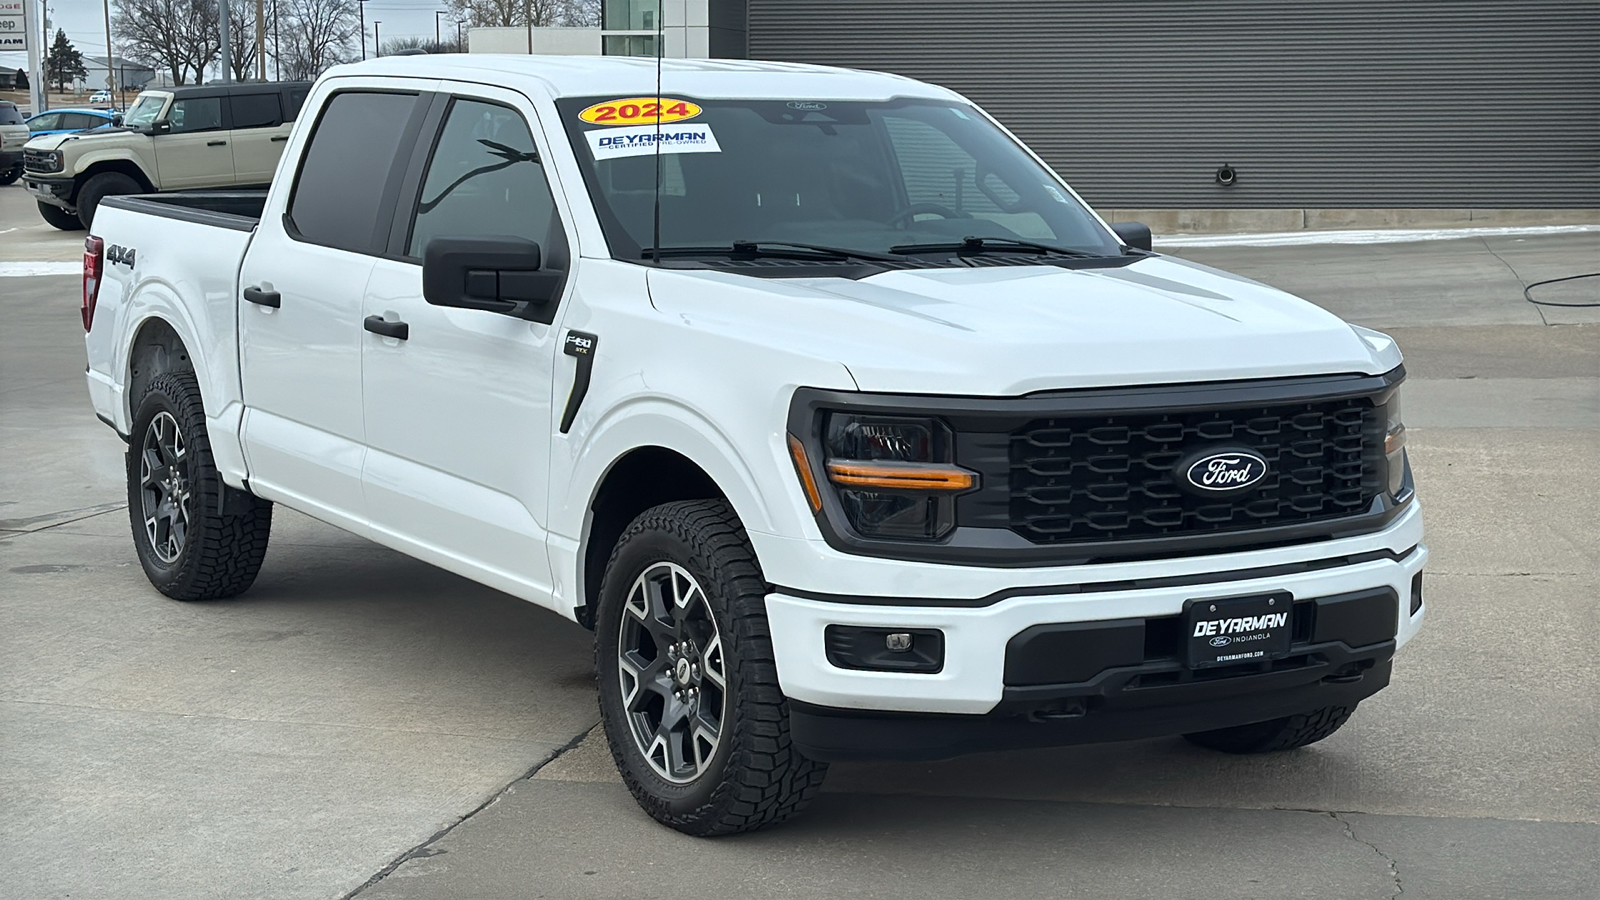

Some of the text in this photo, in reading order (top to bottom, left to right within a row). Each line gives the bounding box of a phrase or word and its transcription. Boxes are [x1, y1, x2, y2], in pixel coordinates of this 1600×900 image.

[594, 102, 690, 122] 2024
[598, 132, 706, 147] DEYARMAN
[608, 142, 654, 150] CERTIFIED
[575, 347, 588, 355] STX
[1202, 458, 1253, 486] Ford
[1193, 612, 1288, 637] DEYARMAN
[1233, 632, 1271, 642] INDIANOLA
[1216, 651, 1264, 661] DEYARMANFORD.COM
